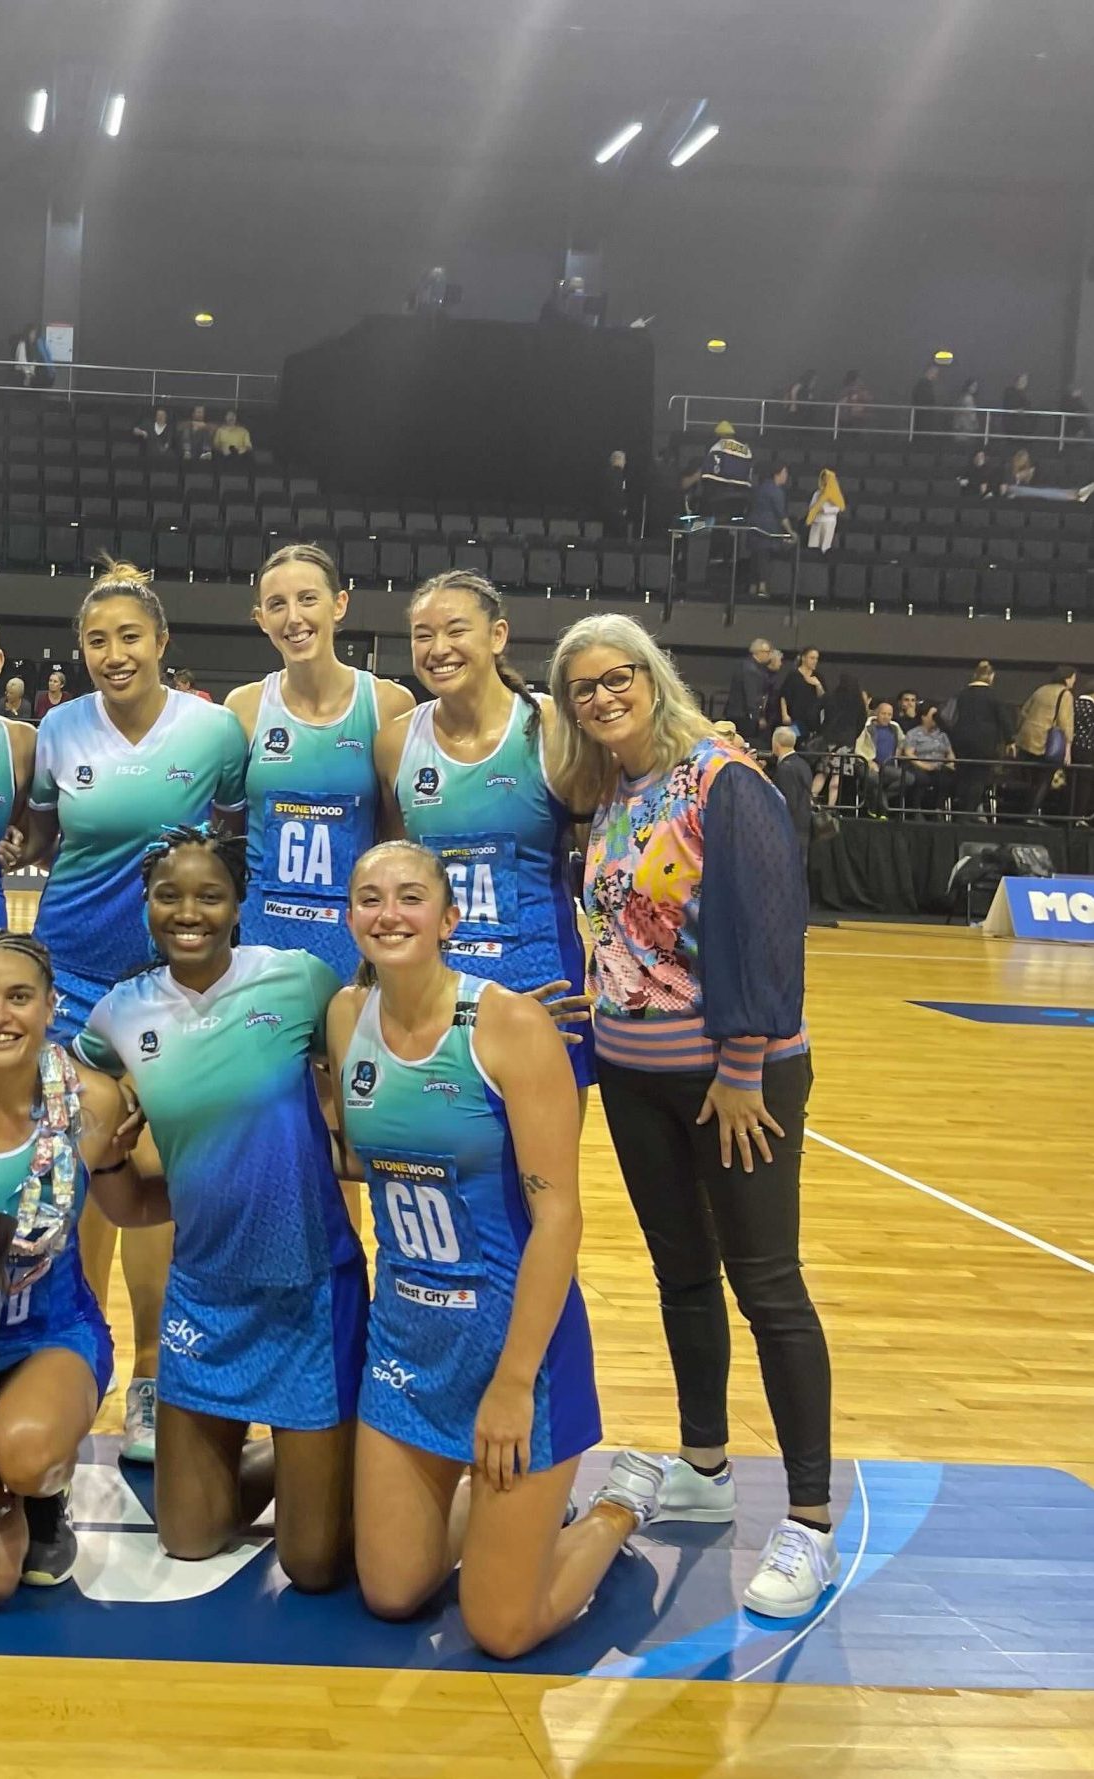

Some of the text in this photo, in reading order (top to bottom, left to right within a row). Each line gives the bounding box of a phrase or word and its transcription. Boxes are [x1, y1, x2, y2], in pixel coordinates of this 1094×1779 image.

[486, 777, 517, 787] MYSTICS
[274, 803, 344, 816] STONEWOOD
[278, 821, 333, 885] GA
[441, 846, 497, 858] STONEWOOD
[266, 901, 319, 921] West City
[457, 942, 481, 954] City
[245, 1014, 283, 1028] MYSTICS
[353, 1079, 372, 1091] ANZ
[423, 1082, 461, 1094] MYSTICS
[372, 1160, 445, 1178] STONEWOOD
[385, 1181, 461, 1263] GD
[397, 1281, 451, 1306] West City
